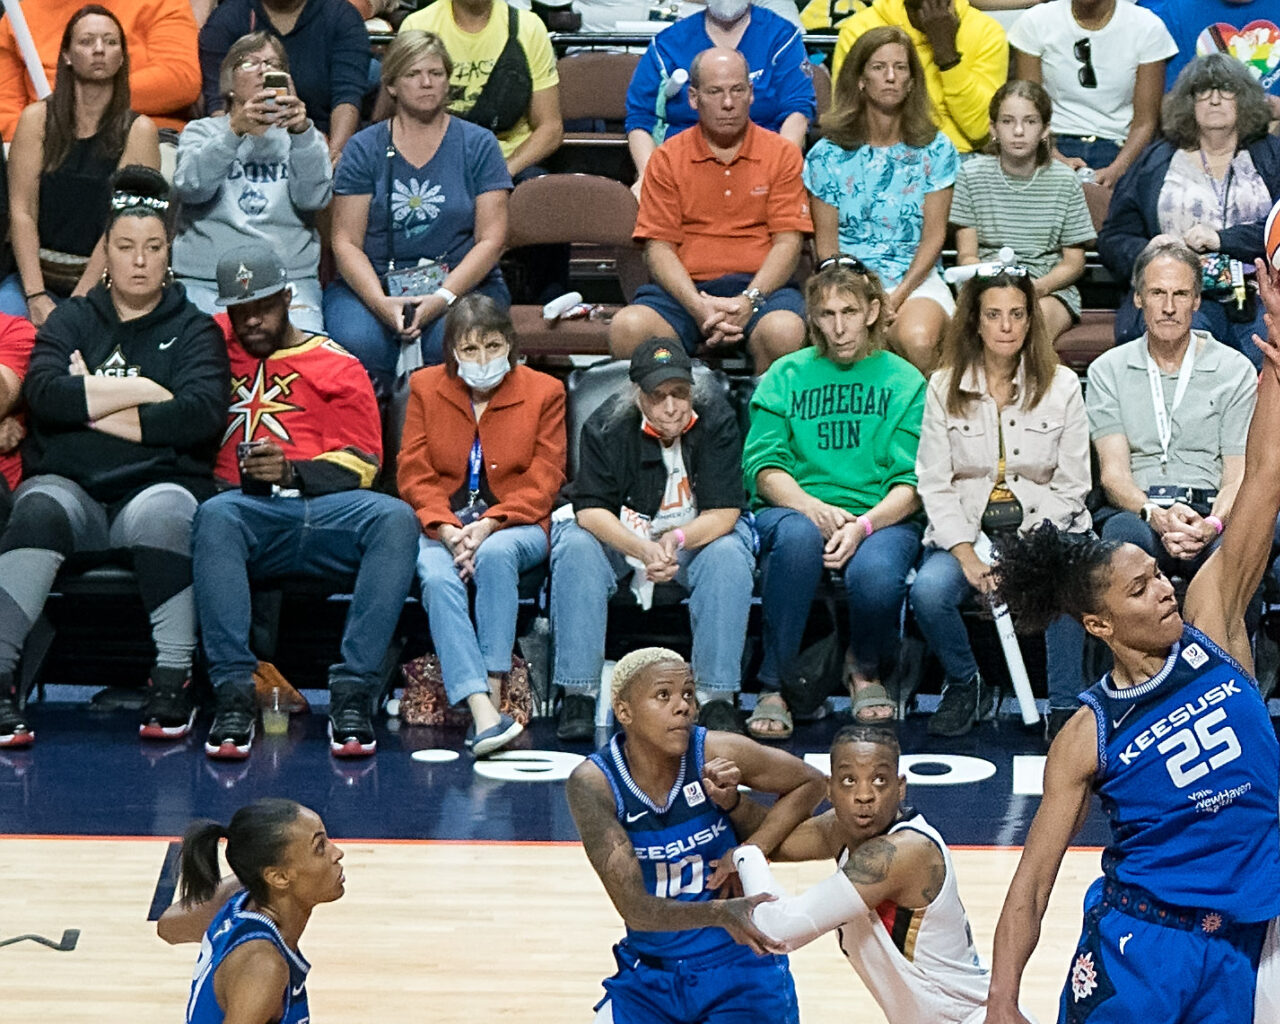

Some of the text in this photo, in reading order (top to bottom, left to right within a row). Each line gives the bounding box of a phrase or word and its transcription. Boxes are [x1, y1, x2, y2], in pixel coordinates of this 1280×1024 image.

[789, 383, 893, 420] MOHEGAN
[818, 419, 861, 450] SUN
[1118, 678, 1242, 766] KEESUSK
[1156, 706, 1242, 789] 25
[1195, 781, 1252, 810] NewHaven
[634, 817, 728, 861] EESUSK
[655, 853, 704, 899] 10
